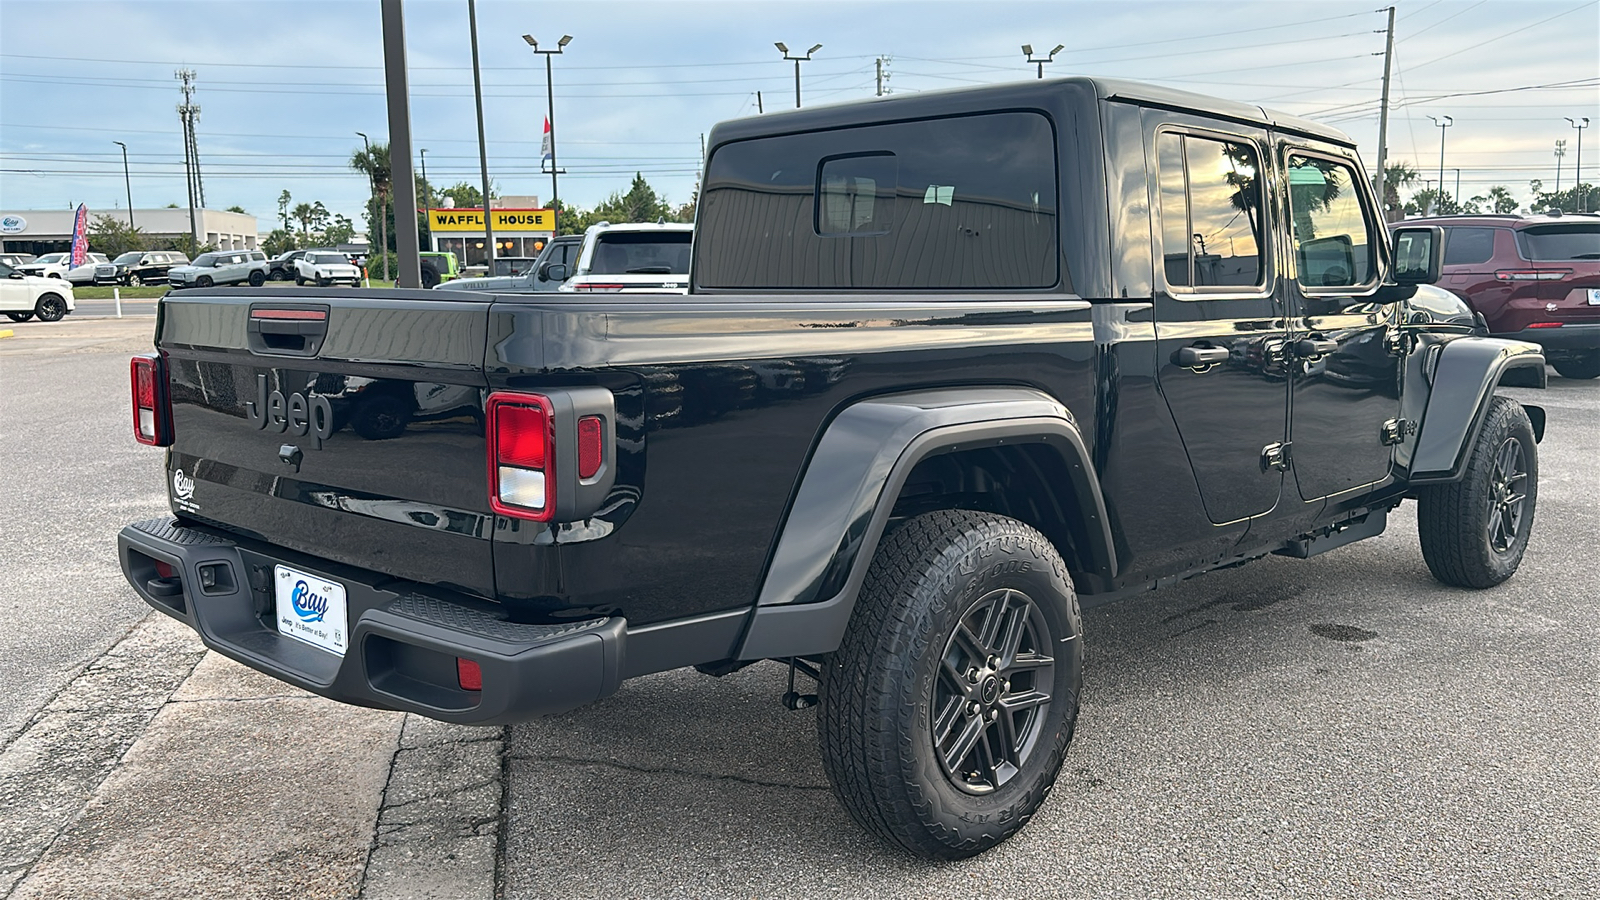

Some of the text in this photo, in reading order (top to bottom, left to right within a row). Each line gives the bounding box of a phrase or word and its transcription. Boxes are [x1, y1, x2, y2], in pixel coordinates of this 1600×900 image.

[436, 215, 543, 225] WAFFL HOUSE
[661, 281, 679, 289] Jeep
[246, 373, 333, 451] Jeep
[292, 579, 329, 623] Bay
